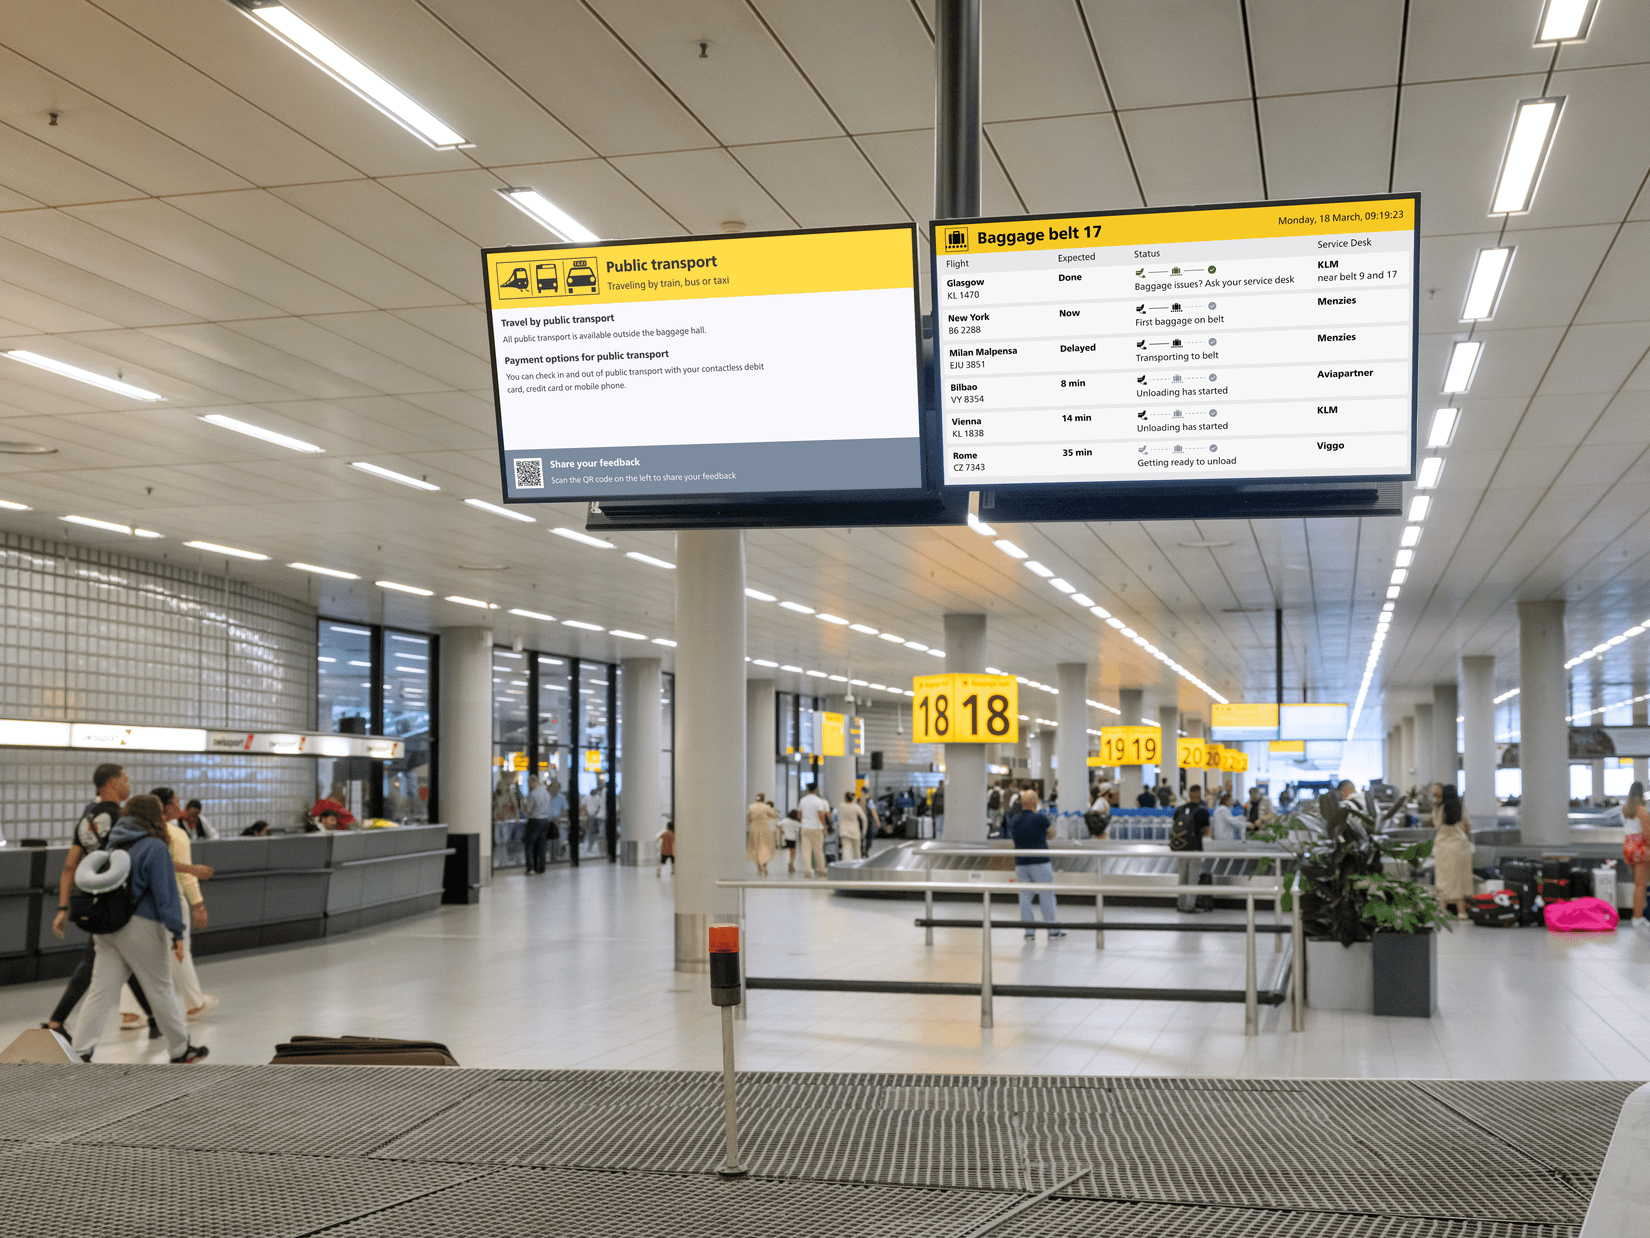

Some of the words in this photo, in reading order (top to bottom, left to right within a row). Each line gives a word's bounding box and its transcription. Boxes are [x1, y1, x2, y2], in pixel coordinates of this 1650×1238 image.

[1278, 216, 1317, 226] Monday,
[1320, 214, 1330, 223] 18
[1332, 213, 1363, 222] March,
[1365, 210, 1404, 220] 09:19:23
[978, 231, 1045, 246] Baggage
[1049, 226, 1079, 240] belt
[1084, 225, 1102, 238] 17
[1318, 240, 1348, 248] Service
[1351, 238, 1372, 247] Desk
[1058, 253, 1095, 263] Expected
[1134, 250, 1160, 258] Status
[606, 259, 648, 273] Public
[651, 256, 717, 271] transport
[946, 260, 969, 269] Flight
[1318, 260, 1339, 269] KLM
[1318, 274, 1337, 282] near
[1340, 272, 1357, 281] belt
[1359, 272, 1364, 280] 9
[1367, 271, 1384, 279] and
[1387, 270, 1397, 279] 17
[607, 280, 646, 291] Traveling
[647, 278, 658, 290] by
[660, 278, 683, 288] train,
[684, 277, 700, 287] bus
[702, 277, 711, 285] or
[712, 276, 729, 285] taxi
[947, 279, 985, 288] Glasgow
[1135, 283, 1172, 292] Baggage
[1174, 280, 1203, 289] issues?
[1205, 279, 1220, 287] Ask
[1222, 279, 1241, 288] your
[1243, 277, 1273, 286] service
[1275, 275, 1295, 284] desk
[960, 291, 979, 299] 1470
[1317, 297, 1356, 305] Menzies
[948, 314, 968, 322] New
[970, 313, 990, 321] York
[1059, 309, 1080, 317] Now
[501, 318, 528, 327] Travel
[529, 317, 541, 328] by
[543, 315, 570, 327] public
[572, 314, 615, 325] transport
[1135, 318, 1153, 326] First
[1155, 317, 1192, 327] baggage
[1208, 315, 1225, 323] belt
[503, 335, 513, 343] All
[514, 333, 536, 344] public
[537, 333, 570, 342] transport
[579, 330, 612, 340] available
[613, 329, 640, 338] outside
[642, 328, 654, 337] the
[656, 327, 689, 337] baggage
[690, 326, 706, 335] hall.
[960, 326, 981, 334] 2288
[1317, 333, 1356, 342] Menzies
[949, 349, 974, 357] Milan
[975, 348, 1017, 357] Malpensa
[1060, 344, 1096, 354] Delayed
[505, 355, 544, 366] Payment
[545, 353, 579, 364] options
[581, 353, 595, 362] for
[596, 351, 624, 363] public
[626, 350, 669, 361] transport
[1136, 353, 1189, 363] Transporting
[1202, 351, 1219, 359] belt
[966, 361, 985, 369] 3851
[506, 373, 520, 381] You
[535, 370, 556, 379] check
[557, 370, 564, 378] in
[565, 369, 580, 378] and
[581, 369, 594, 377] out
[596, 368, 603, 376] of
[605, 367, 627, 378] public
[629, 366, 663, 376] transport
[664, 365, 681, 374] with
[682, 366, 700, 376] your
[701, 363, 743, 373] contactless
[744, 363, 764, 371] debit
[1317, 370, 1373, 379] Aviapartner
[507, 385, 524, 394] card,
[526, 384, 546, 393] credit
[548, 383, 563, 391] card
[574, 382, 599, 391] mobile
[601, 381, 626, 392] phone.
[1069, 379, 1085, 387] min
[1136, 388, 1180, 398] Unloading
[1198, 386, 1228, 395] started
[964, 395, 984, 403] 8354
[1317, 406, 1338, 414] KLM
[1062, 414, 1073, 422] 14
[1137, 423, 1180, 433] Unloading
[1183, 423, 1197, 431] has
[1198, 422, 1228, 430] started
[1317, 442, 1345, 451] Viggo
[953, 452, 977, 460] Rome
[550, 459, 575, 469] Share
[577, 460, 597, 469] your
[599, 457, 640, 467] feedback
[965, 463, 985, 471] 7343
[1138, 458, 1169, 468] Getting
[1171, 458, 1194, 467] ready
[1207, 457, 1237, 465] unload
[551, 476, 568, 484] Scan
[569, 476, 581, 484] the
[583, 475, 594, 484] QR
[595, 474, 613, 483] code
[625, 474, 638, 482] the
[640, 473, 652, 482] left
[663, 473, 682, 481] share
[684, 473, 701, 482] your
[702, 471, 736, 480] feedback
[920, 694, 949, 736] 18
[963, 695, 1010, 736] 18
[1106, 739, 1125, 761] 19
[1133, 738, 1156, 761] 19
[1182, 747, 1202, 764] 20
